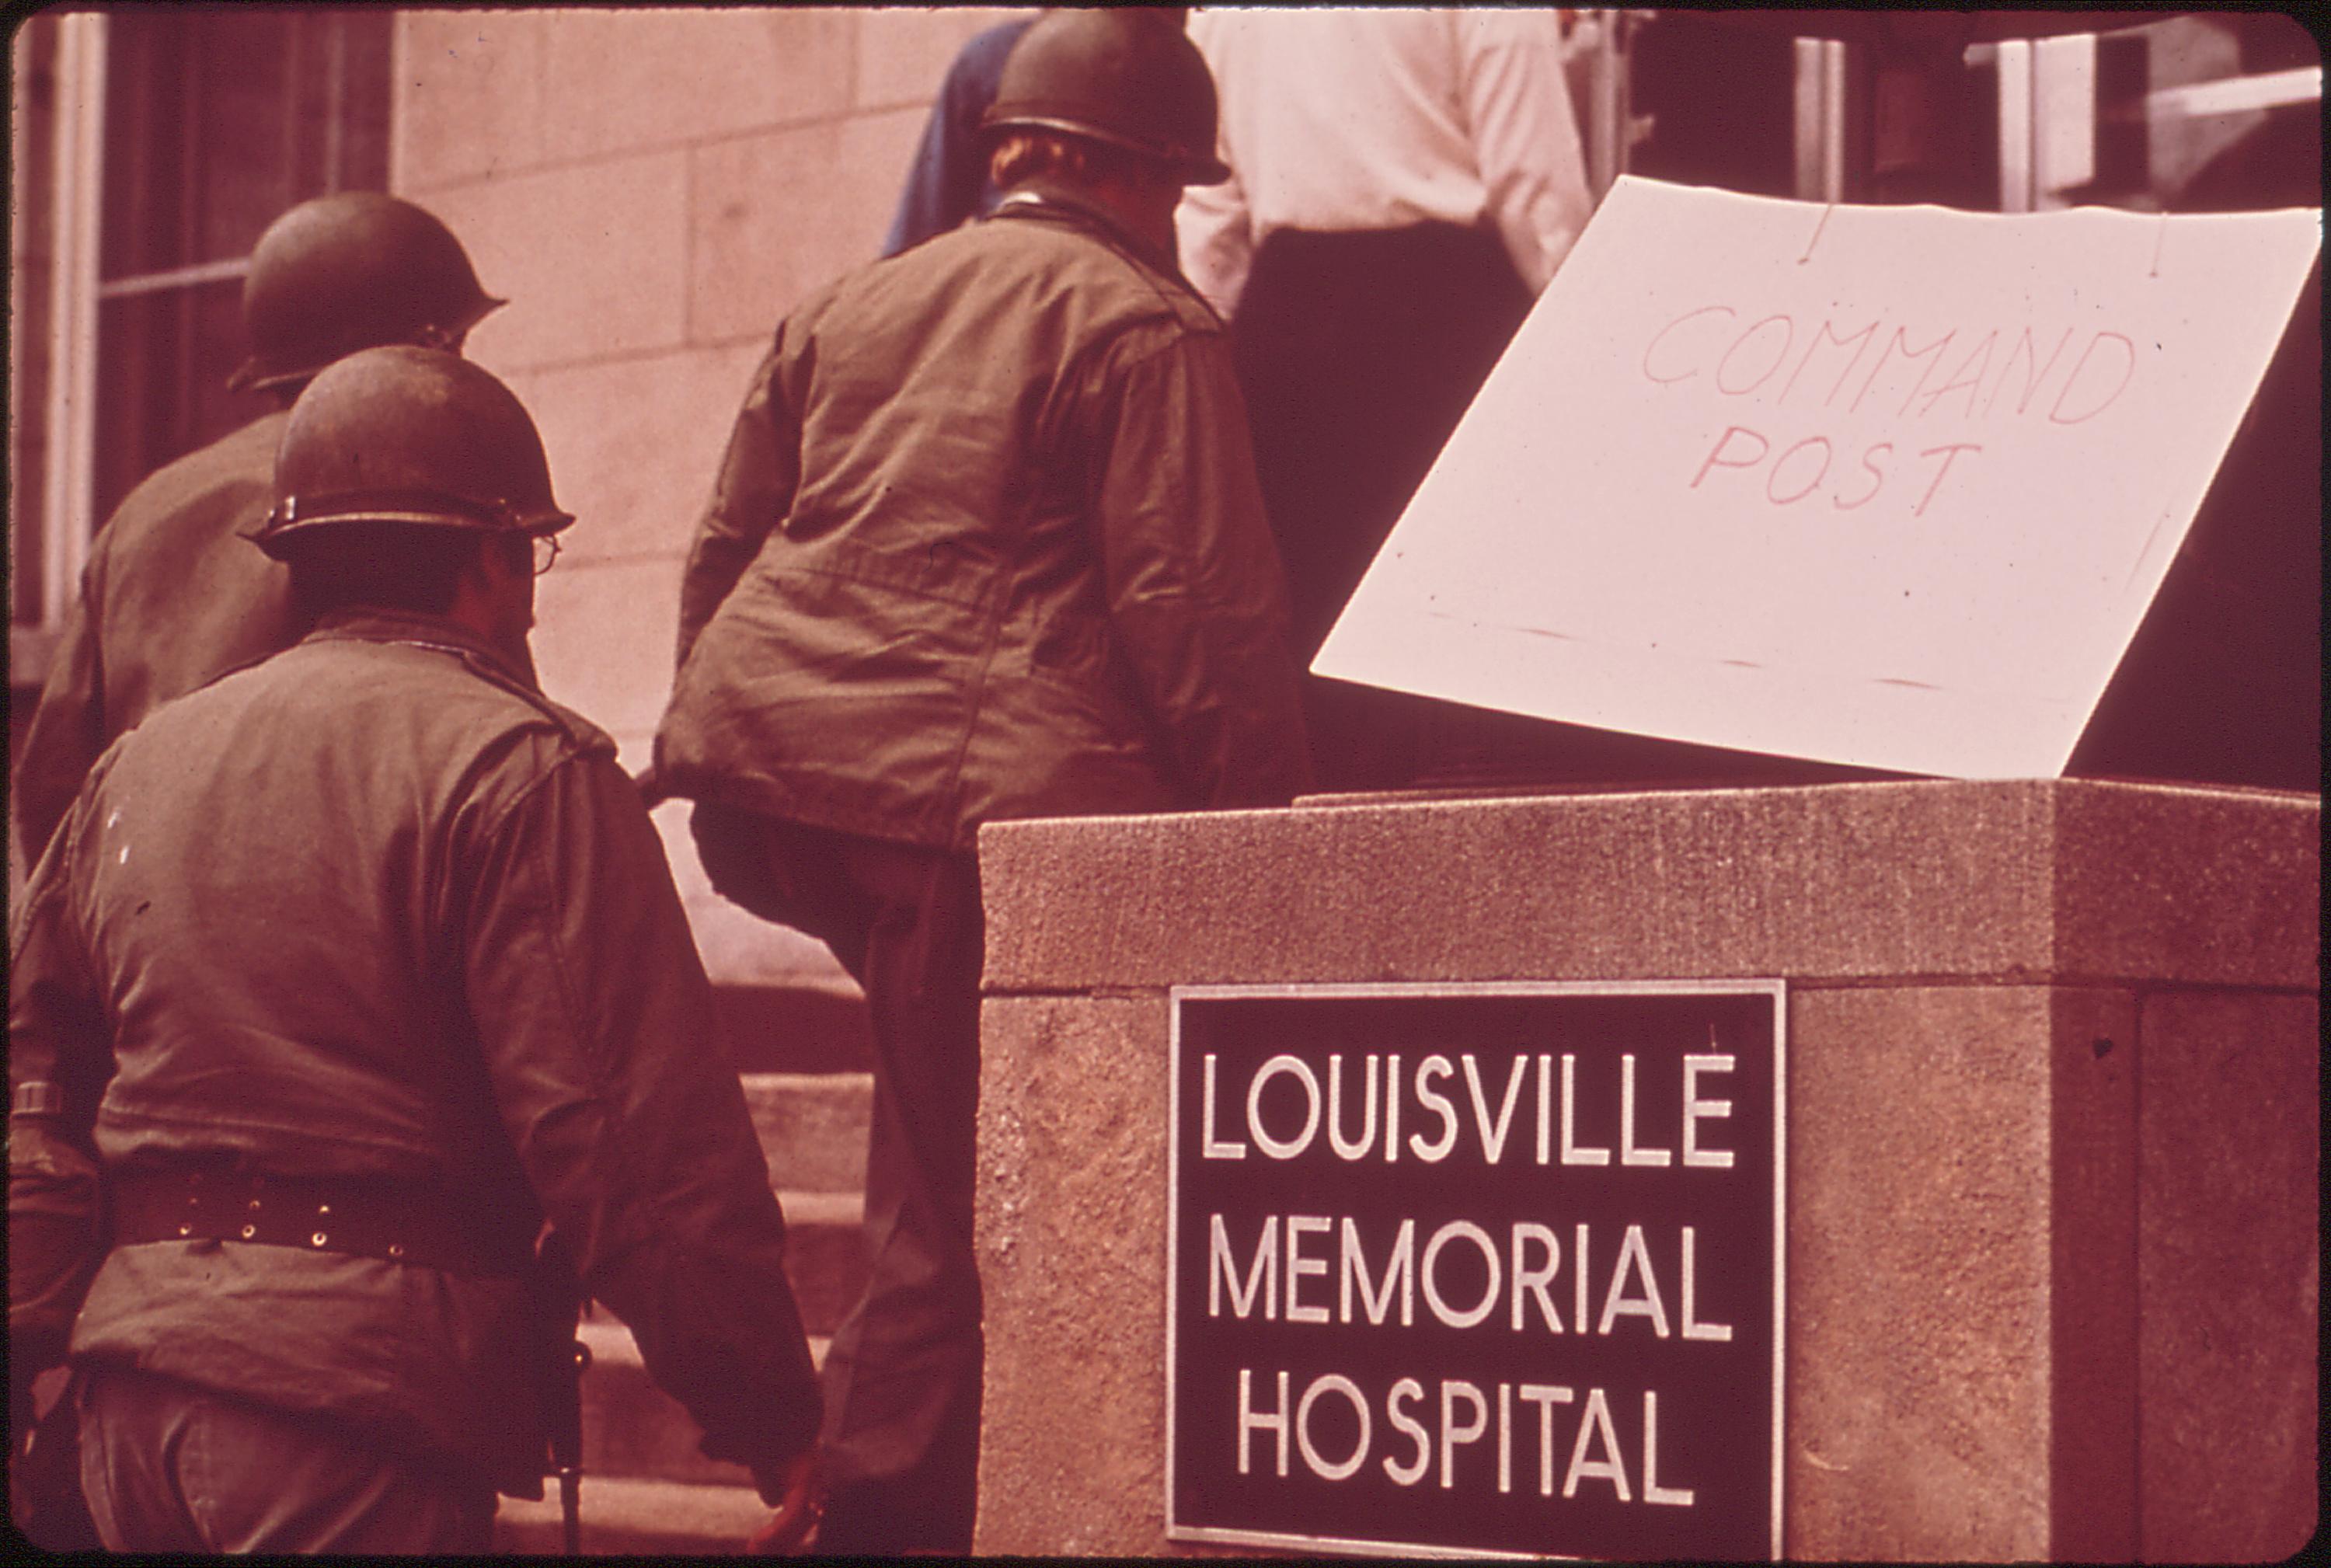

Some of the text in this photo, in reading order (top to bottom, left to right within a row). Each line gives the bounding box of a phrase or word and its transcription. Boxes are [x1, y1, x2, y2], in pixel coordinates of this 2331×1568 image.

[1643, 305, 2136, 424] COMMAND
[1690, 426, 1984, 517] POST
[1202, 1054, 1736, 1168] LOUISVILLE
[1209, 1213, 1733, 1342] MEMORIAL
[1238, 1369, 1695, 1506] HOSPITAL
